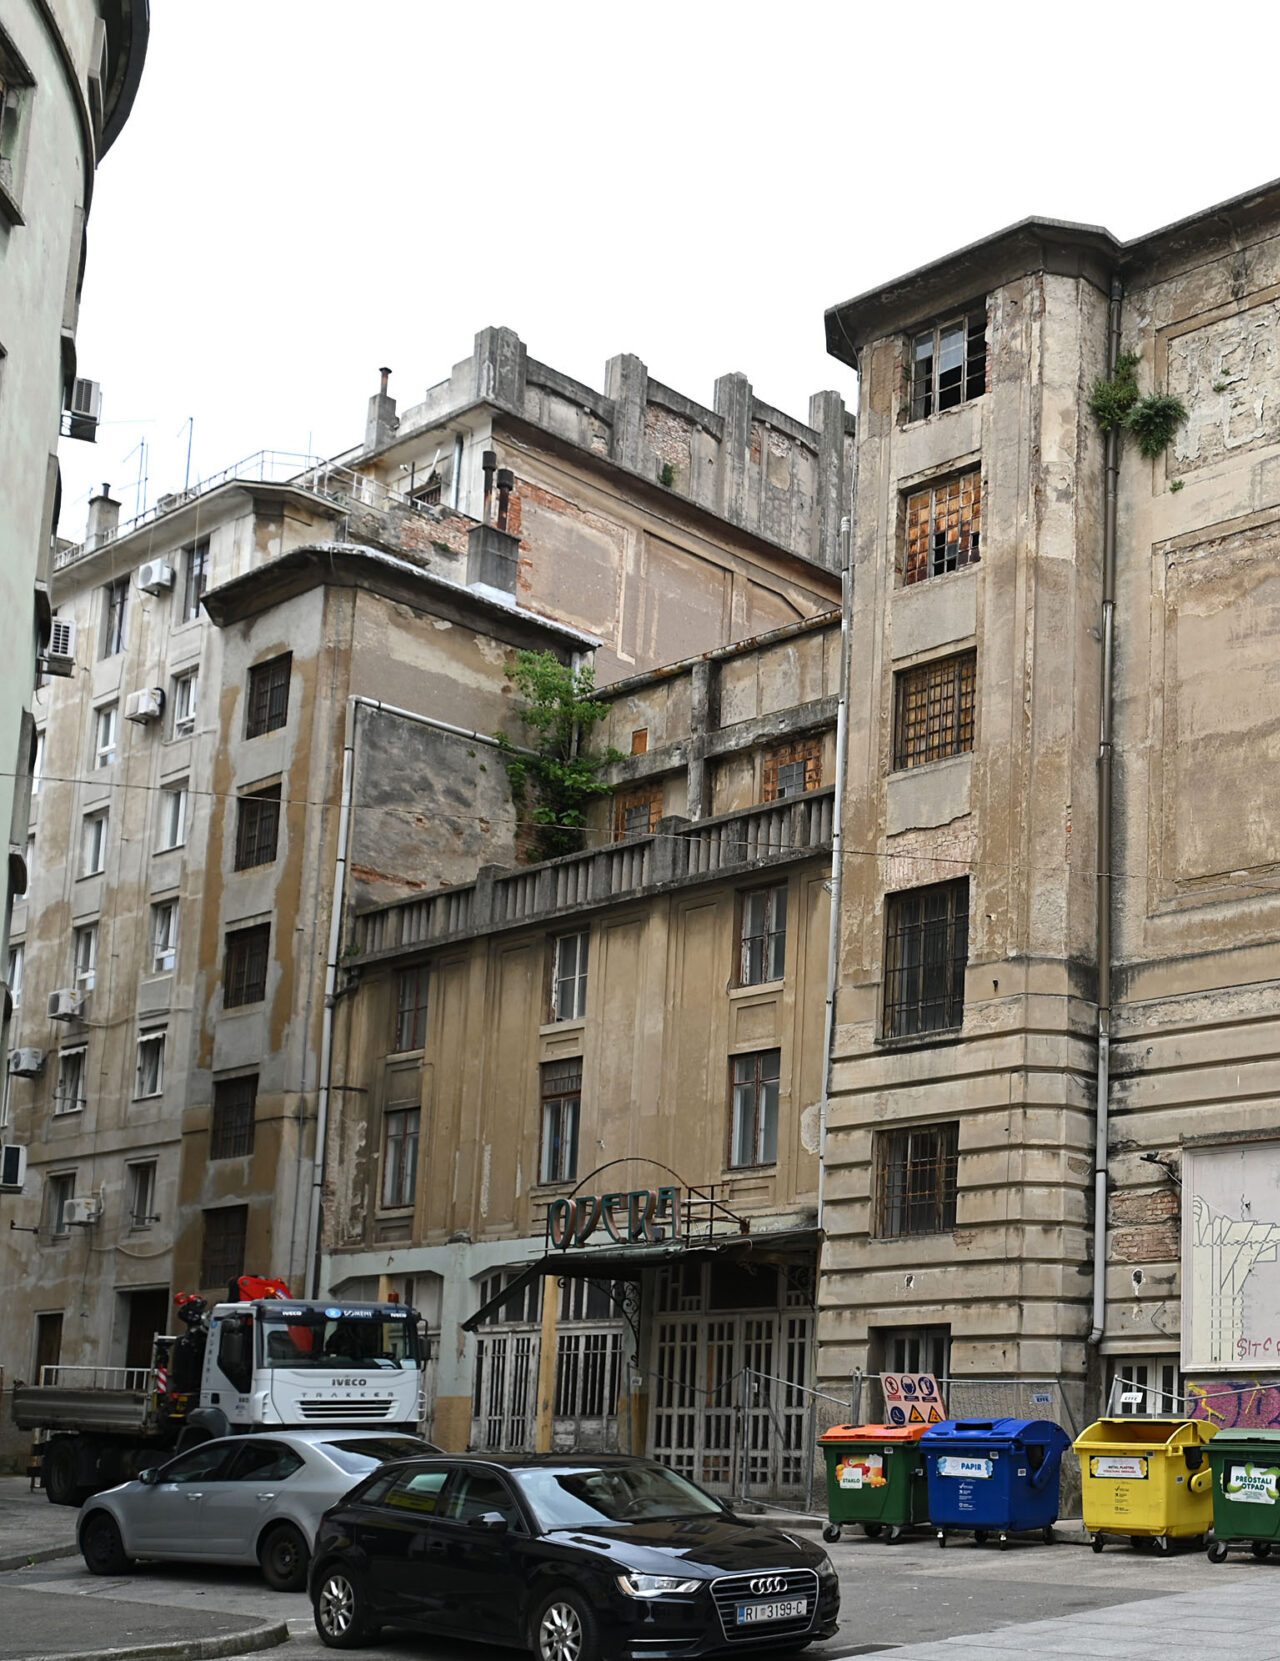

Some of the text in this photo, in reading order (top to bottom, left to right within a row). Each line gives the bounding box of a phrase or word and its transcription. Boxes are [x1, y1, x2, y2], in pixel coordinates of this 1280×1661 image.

[550, 1186, 683, 1250] OPERA
[331, 1378, 368, 1387] IVECO
[961, 1462, 982, 1471] PAPIR
[1235, 1475, 1272, 1485] PREOSTALI
[1241, 1482, 1265, 1491] OTPAD
[745, 1601, 803, 1621] RI 3199-C
